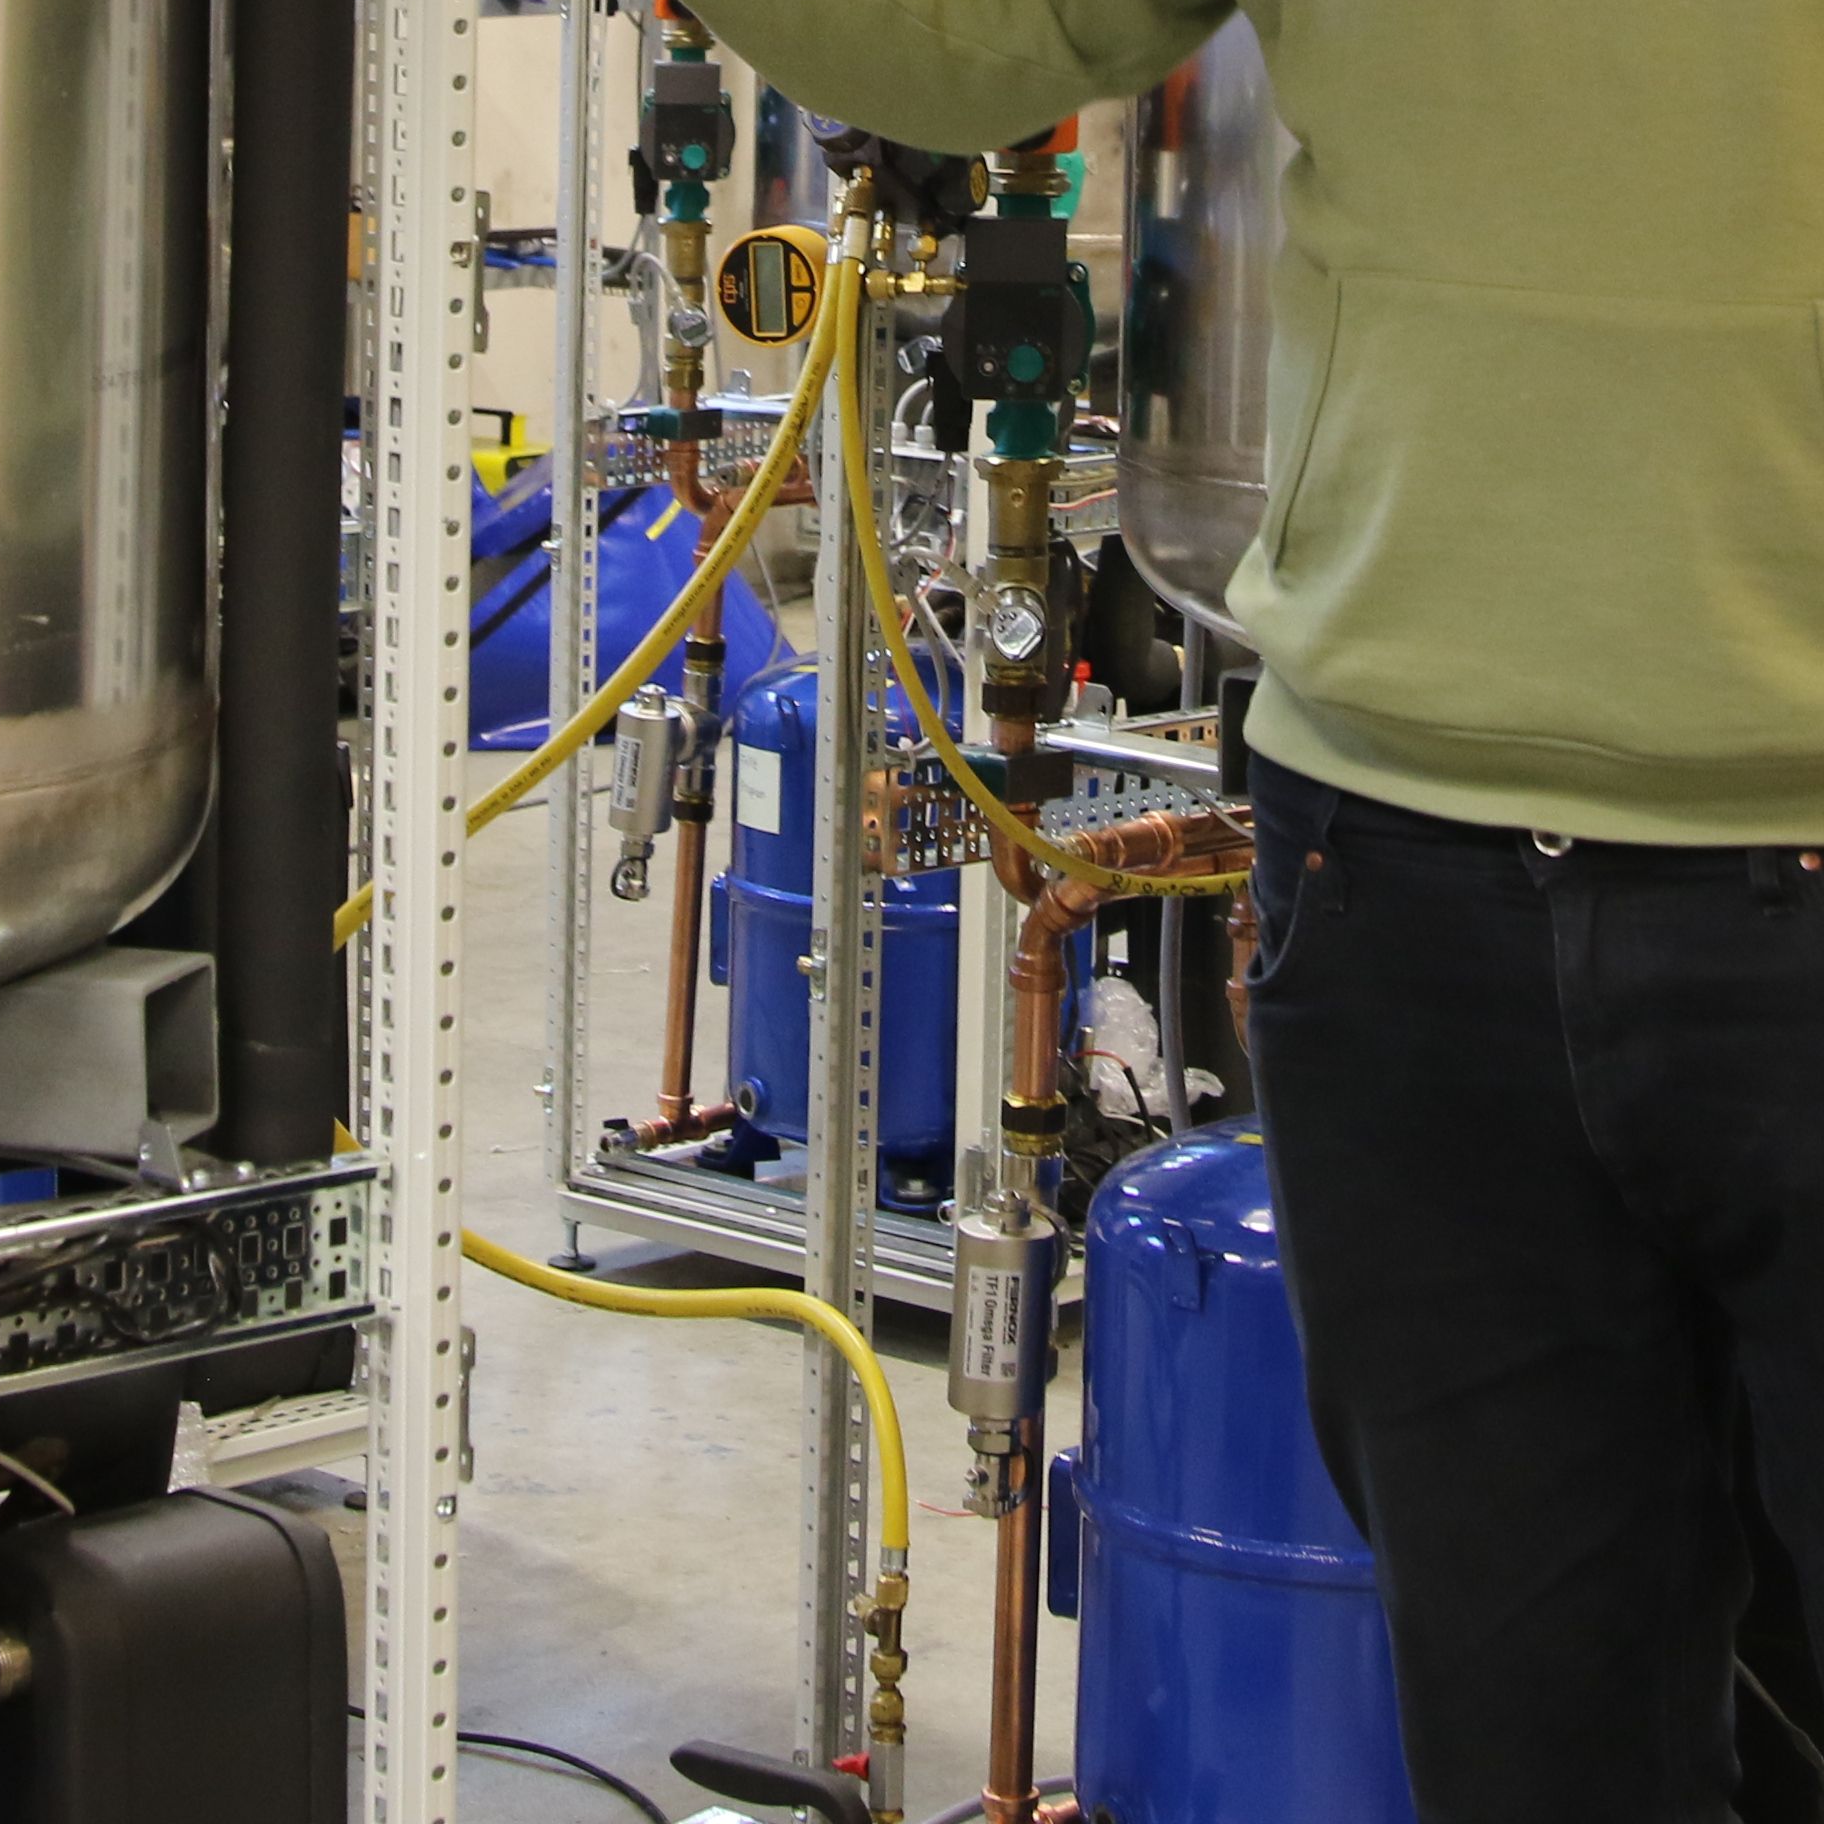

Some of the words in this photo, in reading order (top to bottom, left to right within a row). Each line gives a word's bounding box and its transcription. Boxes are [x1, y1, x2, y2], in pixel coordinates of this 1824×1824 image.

[985, 1275, 999, 1297] TF1
[980, 1299, 998, 1342] Omega
[1007, 1275, 1020, 1345] FERNOX
[980, 1344, 995, 1377] Filter
